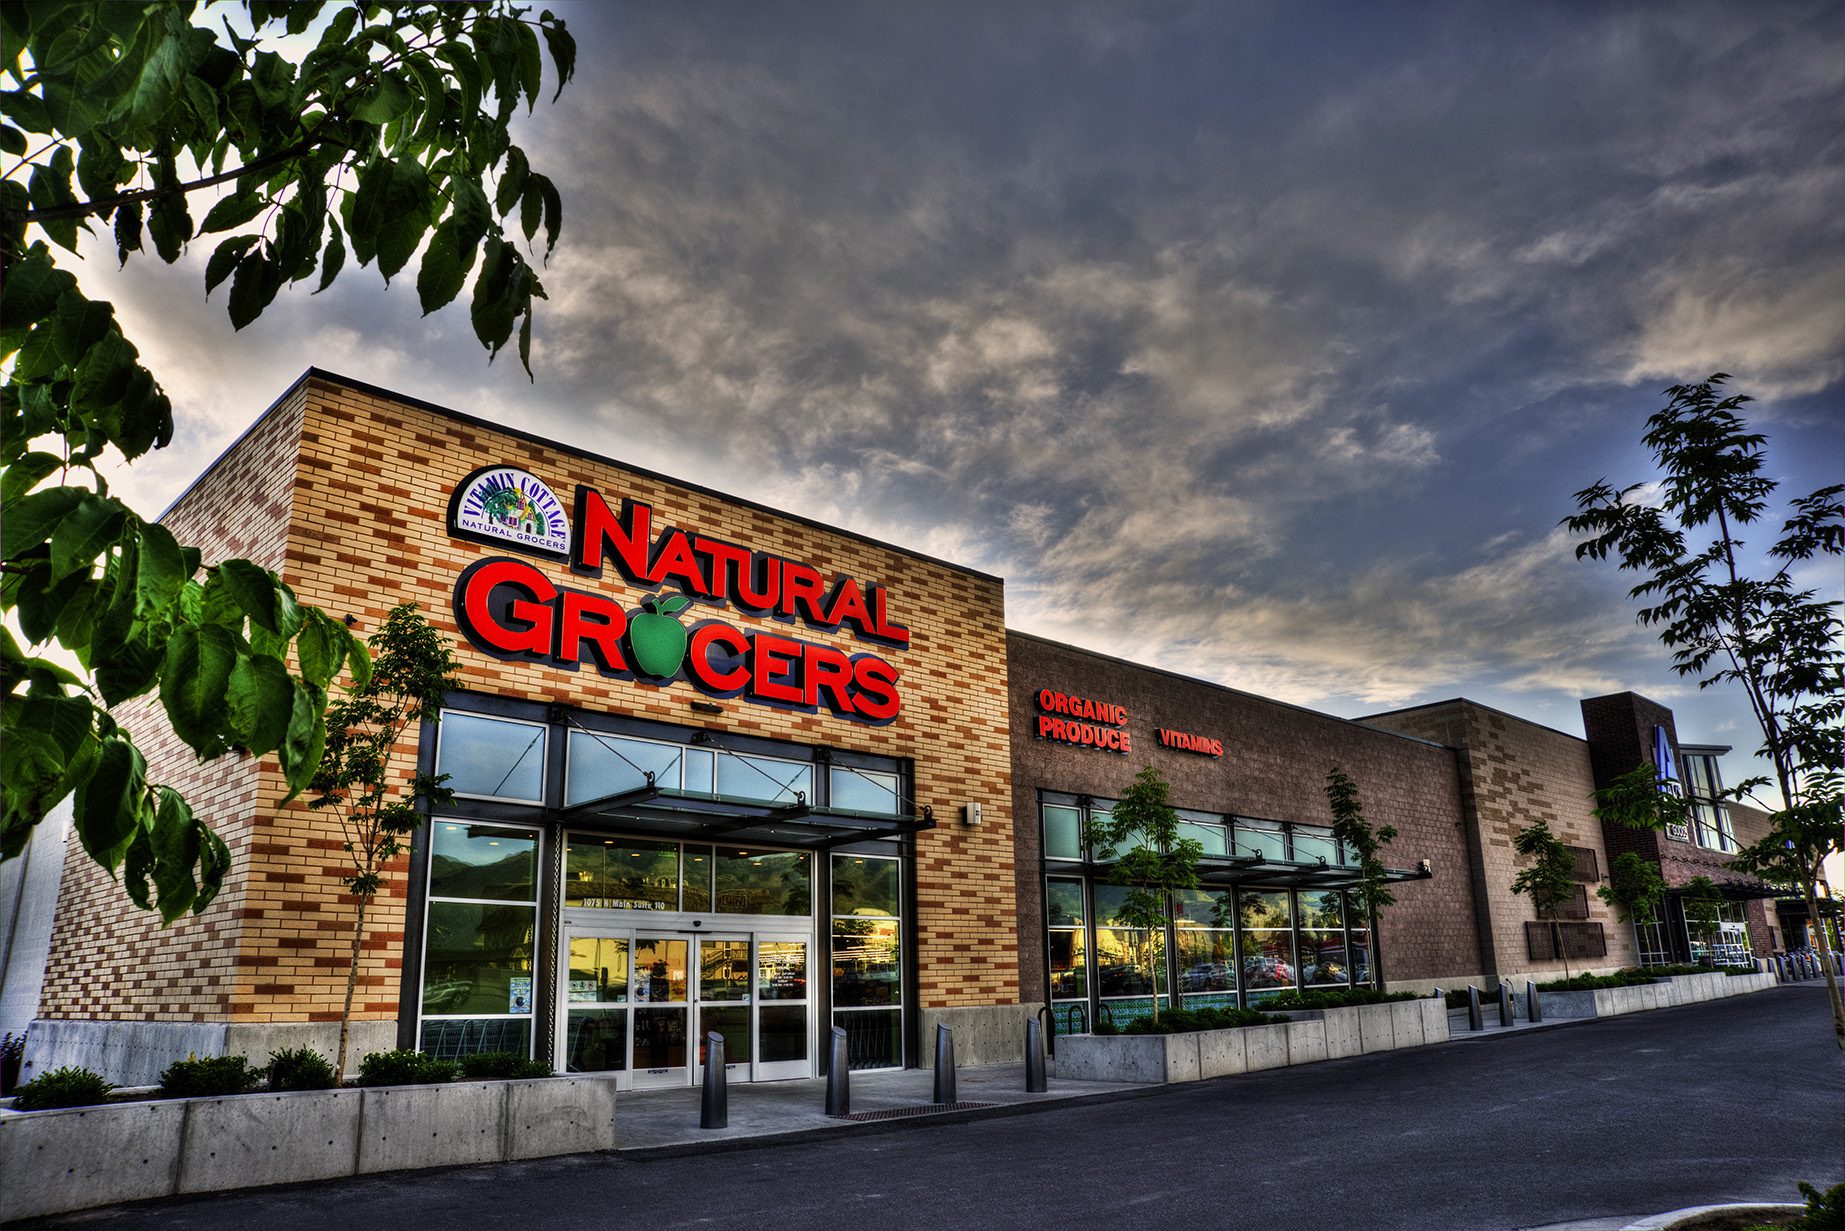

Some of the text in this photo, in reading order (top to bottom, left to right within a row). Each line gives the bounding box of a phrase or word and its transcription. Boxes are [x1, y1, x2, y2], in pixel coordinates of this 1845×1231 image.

[463, 472, 567, 538] VITAMIN COTTAGE
[462, 519, 566, 550] NATURAL GROCERS
[581, 489, 910, 643] NATURAL
[1039, 688, 1128, 727] ORGANIC
[1039, 715, 1132, 752] PRODUCE
[1159, 728, 1224, 757] VITAMINS
[583, 898, 666, 910] 1075 N Main Suite 110
